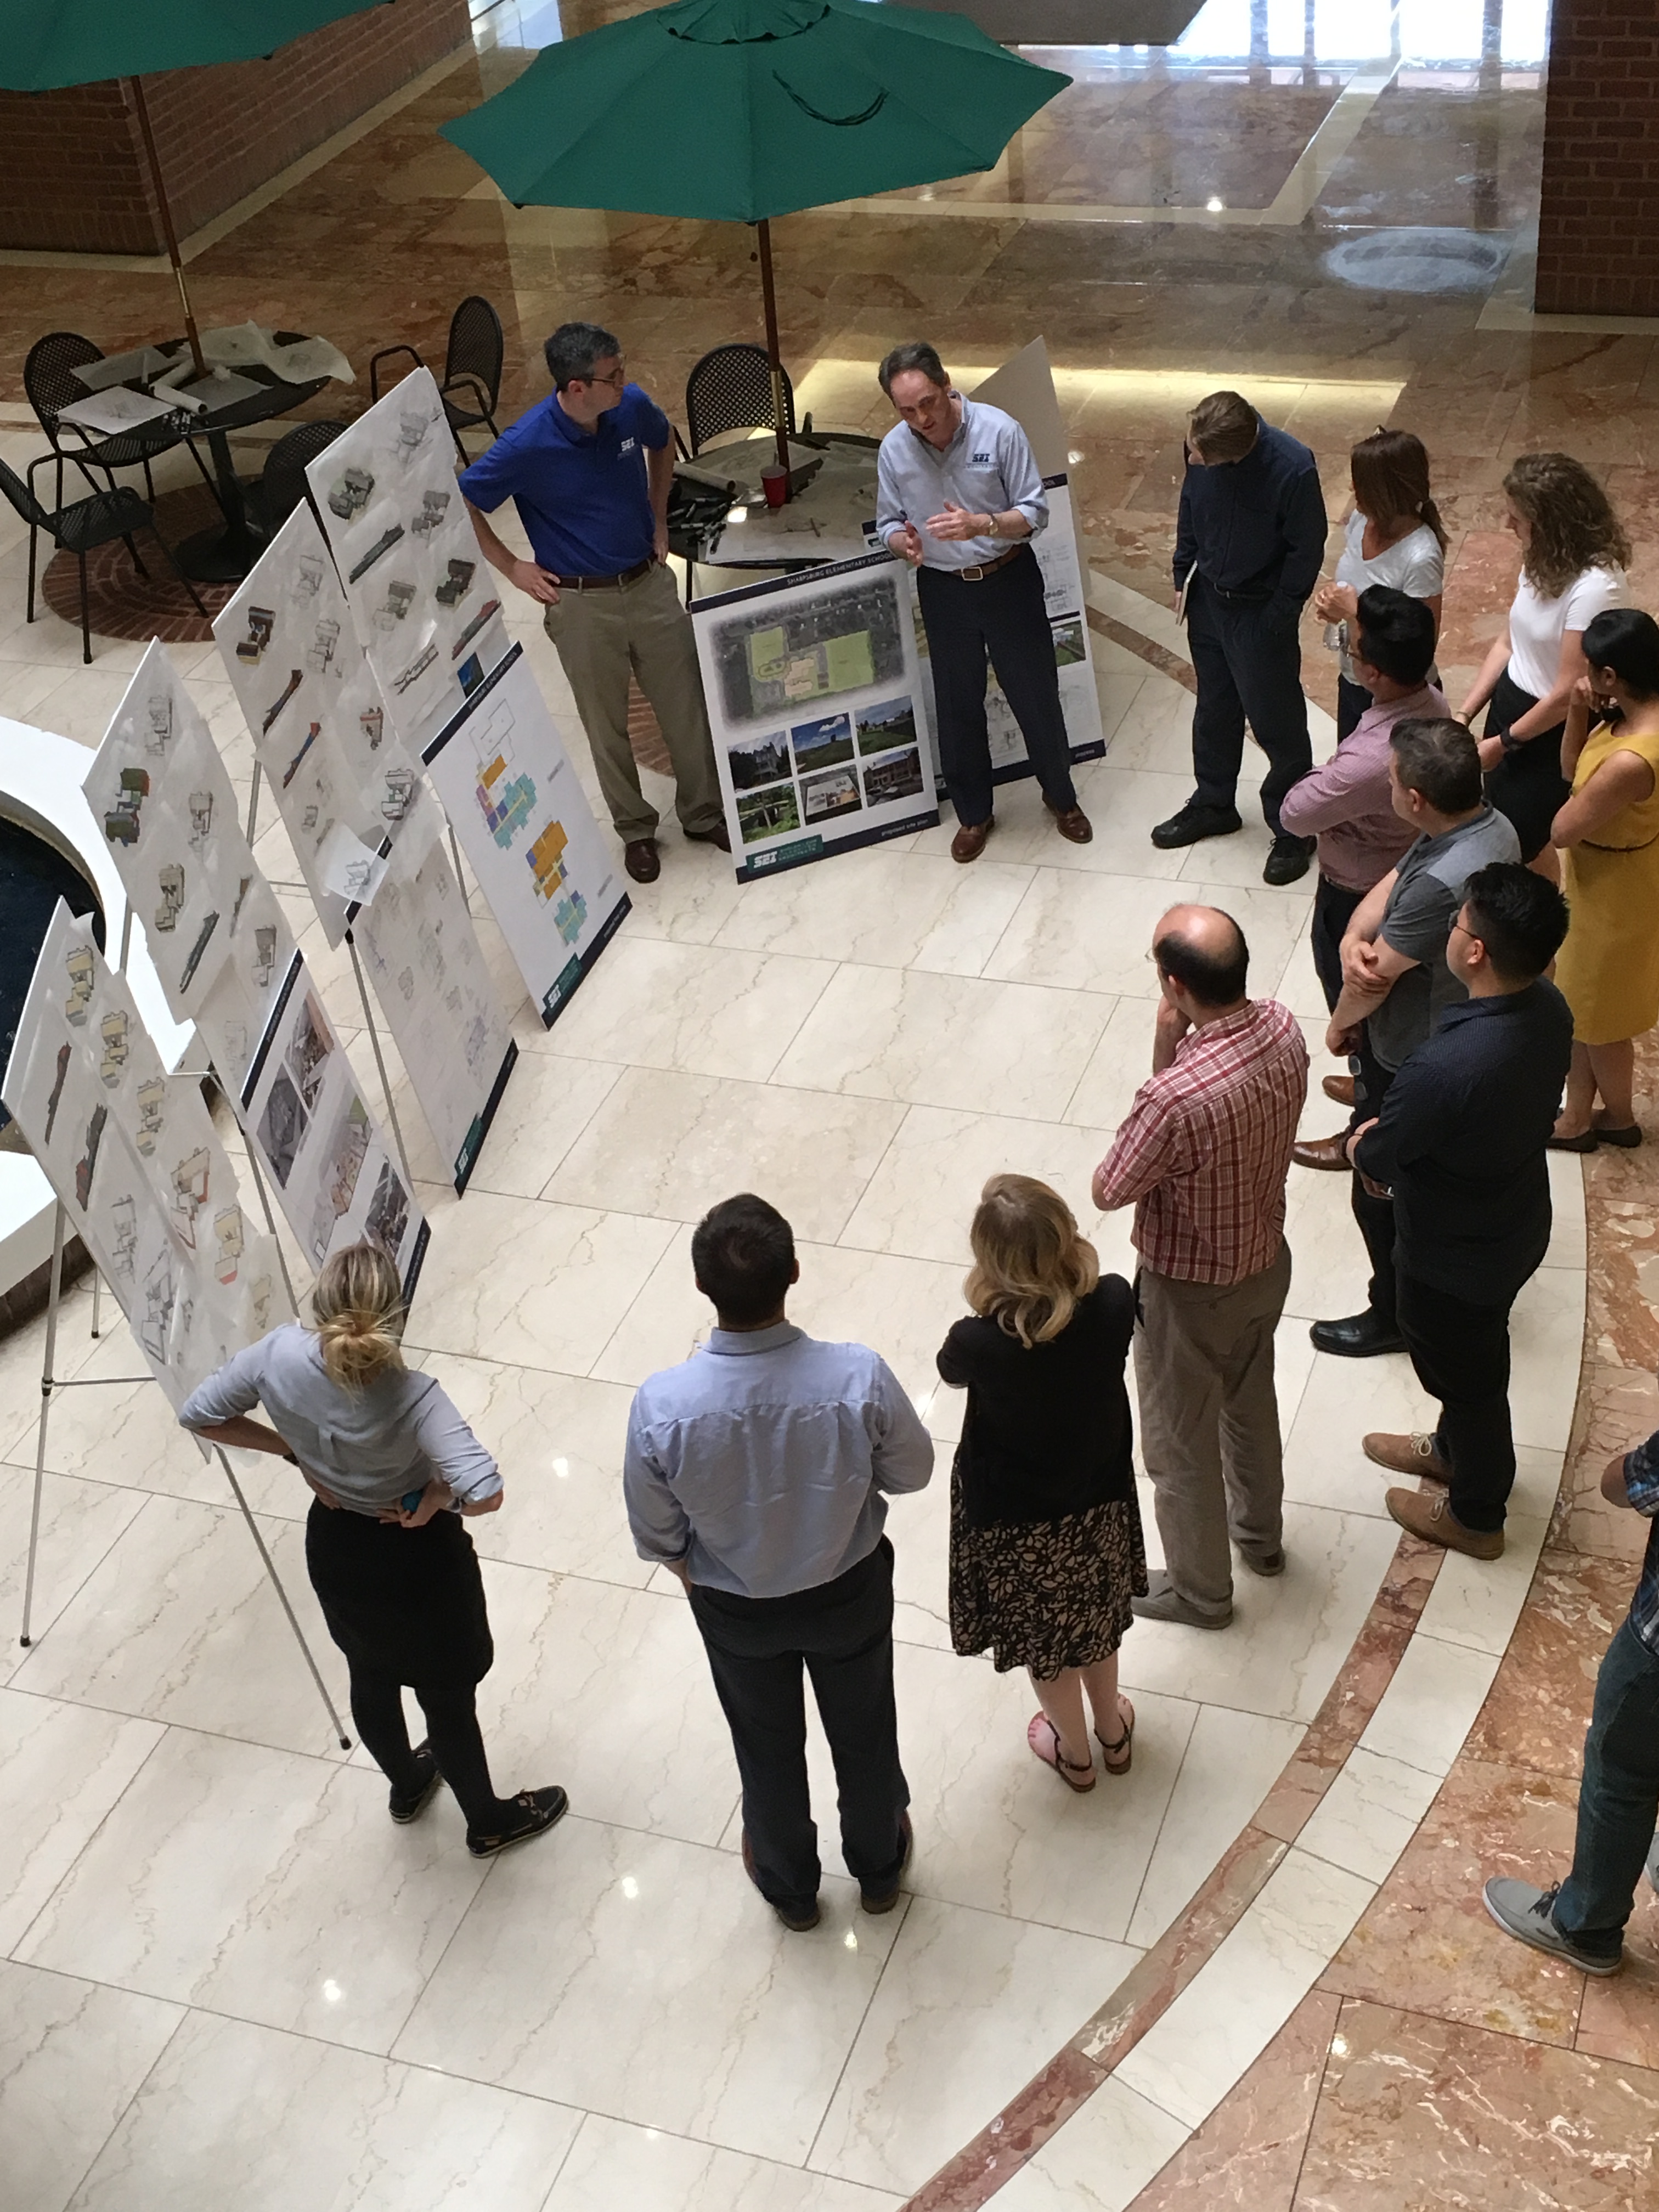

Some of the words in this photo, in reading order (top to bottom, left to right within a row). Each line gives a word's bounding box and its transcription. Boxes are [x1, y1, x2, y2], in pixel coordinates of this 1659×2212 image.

[972, 453, 990, 462] SEI
[825, 559, 866, 575] ELEMENTARY
[753, 851, 778, 868] SEI
